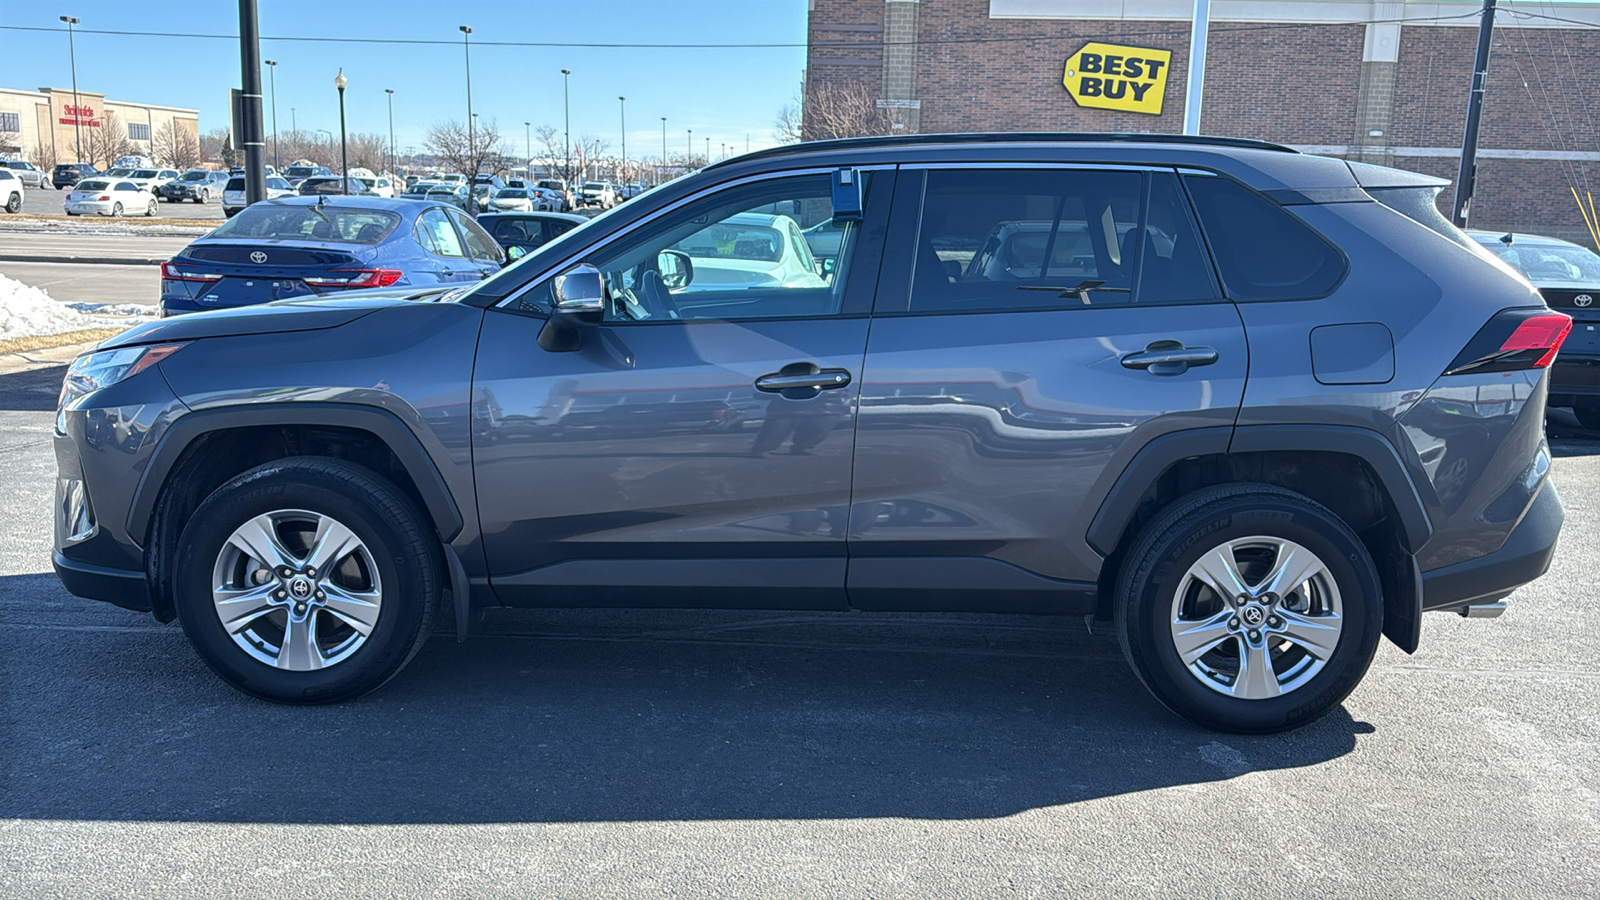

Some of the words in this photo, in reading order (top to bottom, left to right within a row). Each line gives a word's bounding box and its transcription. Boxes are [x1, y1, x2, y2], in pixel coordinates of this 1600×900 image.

[1079, 53, 1165, 80] BEST
[1079, 76, 1154, 102] BUY
[1172, 516, 1230, 559] MICHELIN
